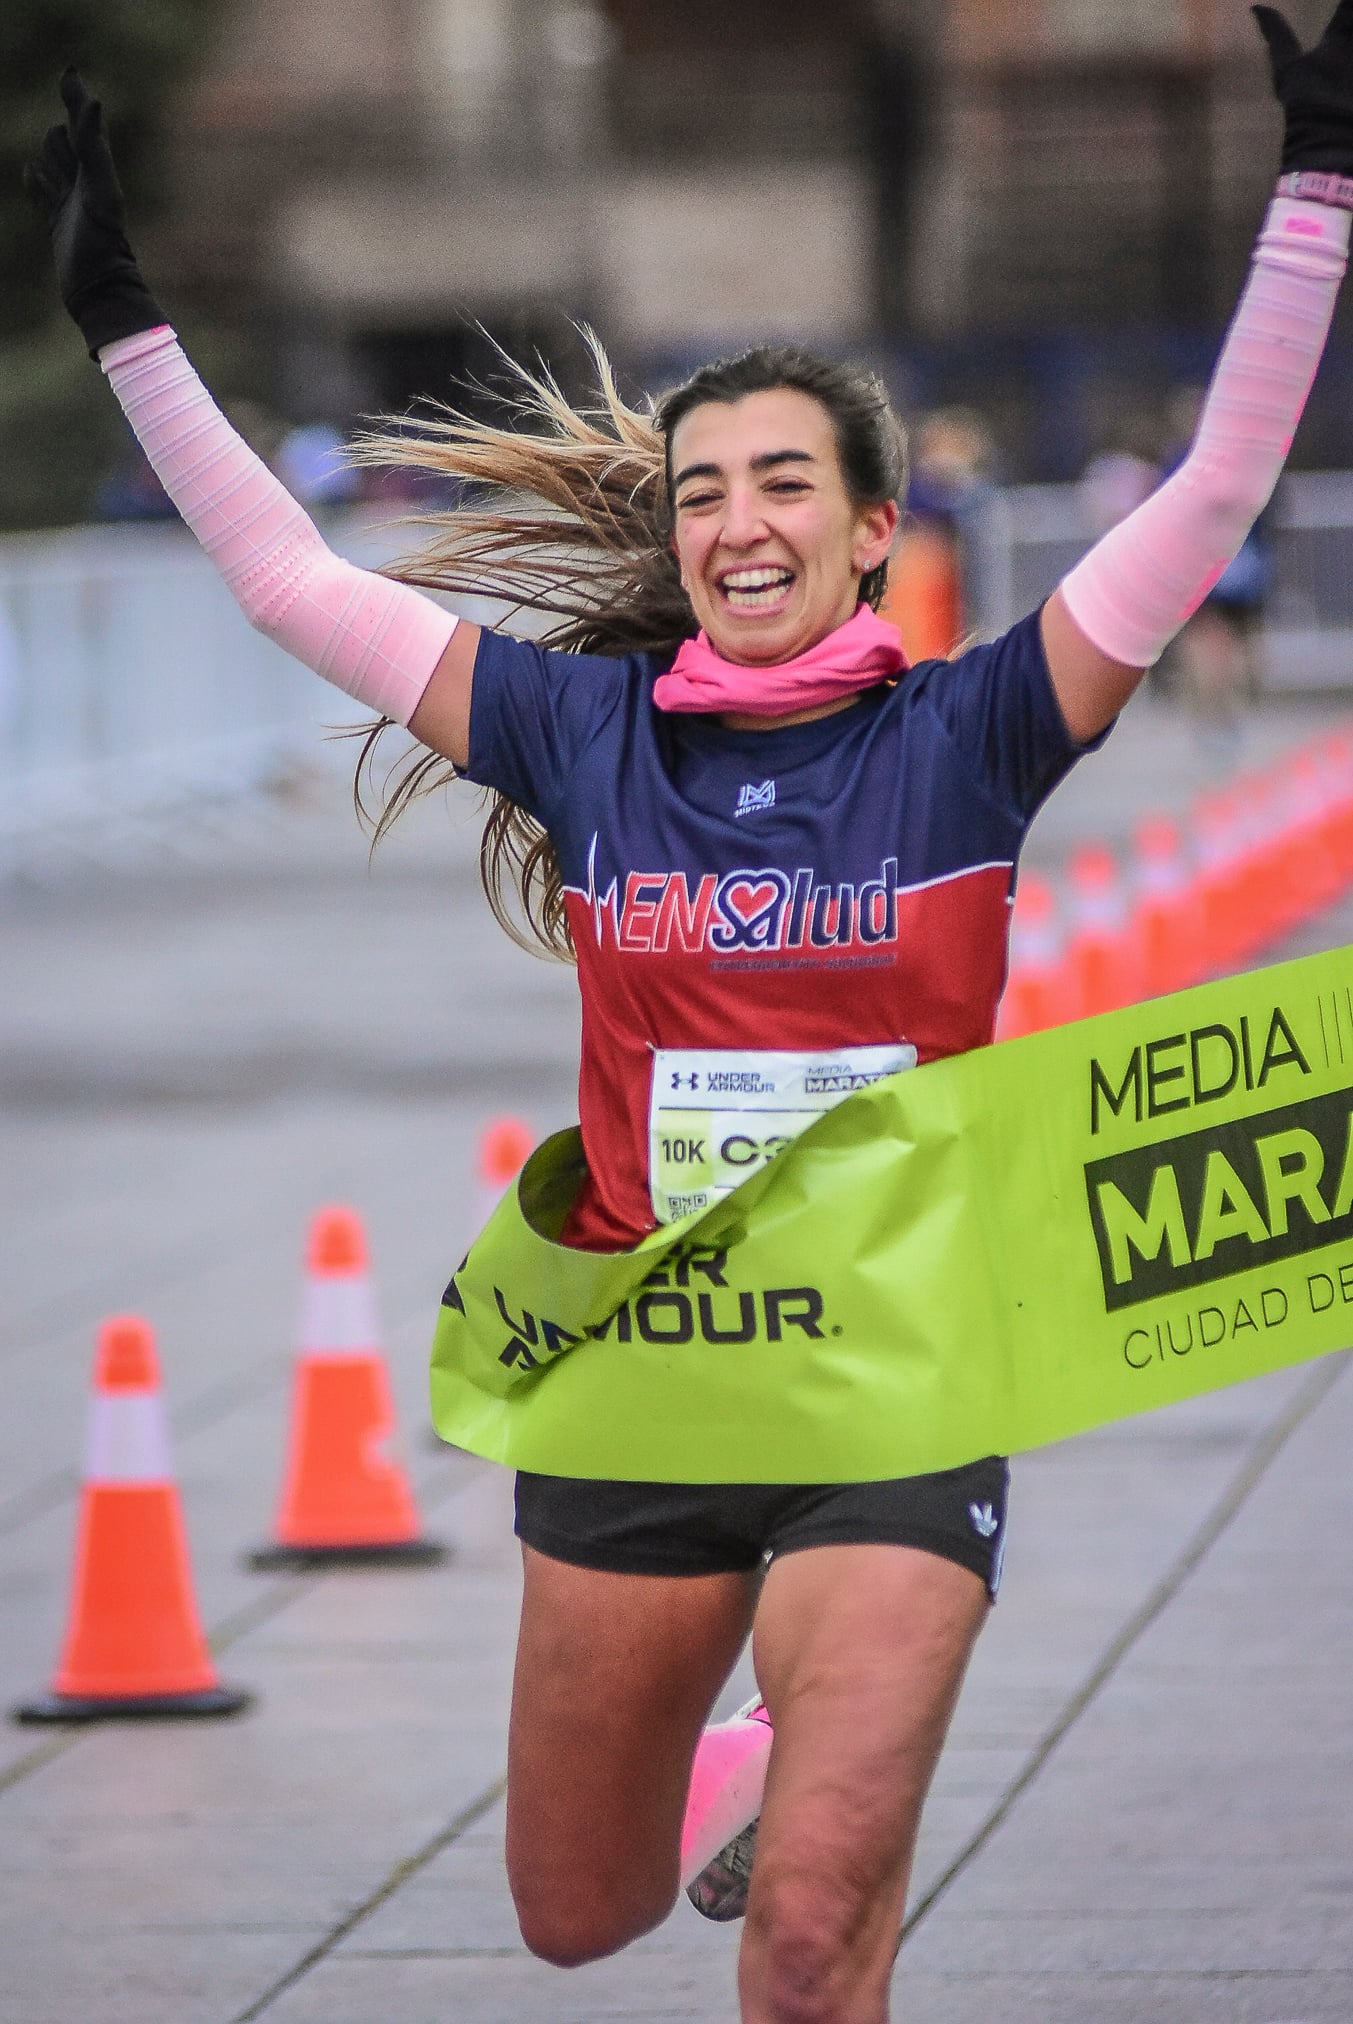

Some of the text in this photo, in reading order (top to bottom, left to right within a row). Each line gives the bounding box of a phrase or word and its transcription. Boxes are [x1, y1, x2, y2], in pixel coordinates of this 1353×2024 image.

[708, 1072, 761, 1082] UNDER
[1091, 1006, 1312, 1136] MEDIA
[707, 1082, 775, 1093] ARMOUR
[662, 1138, 706, 1164] 10K
[1123, 1288, 1289, 1369] CIUDAD
